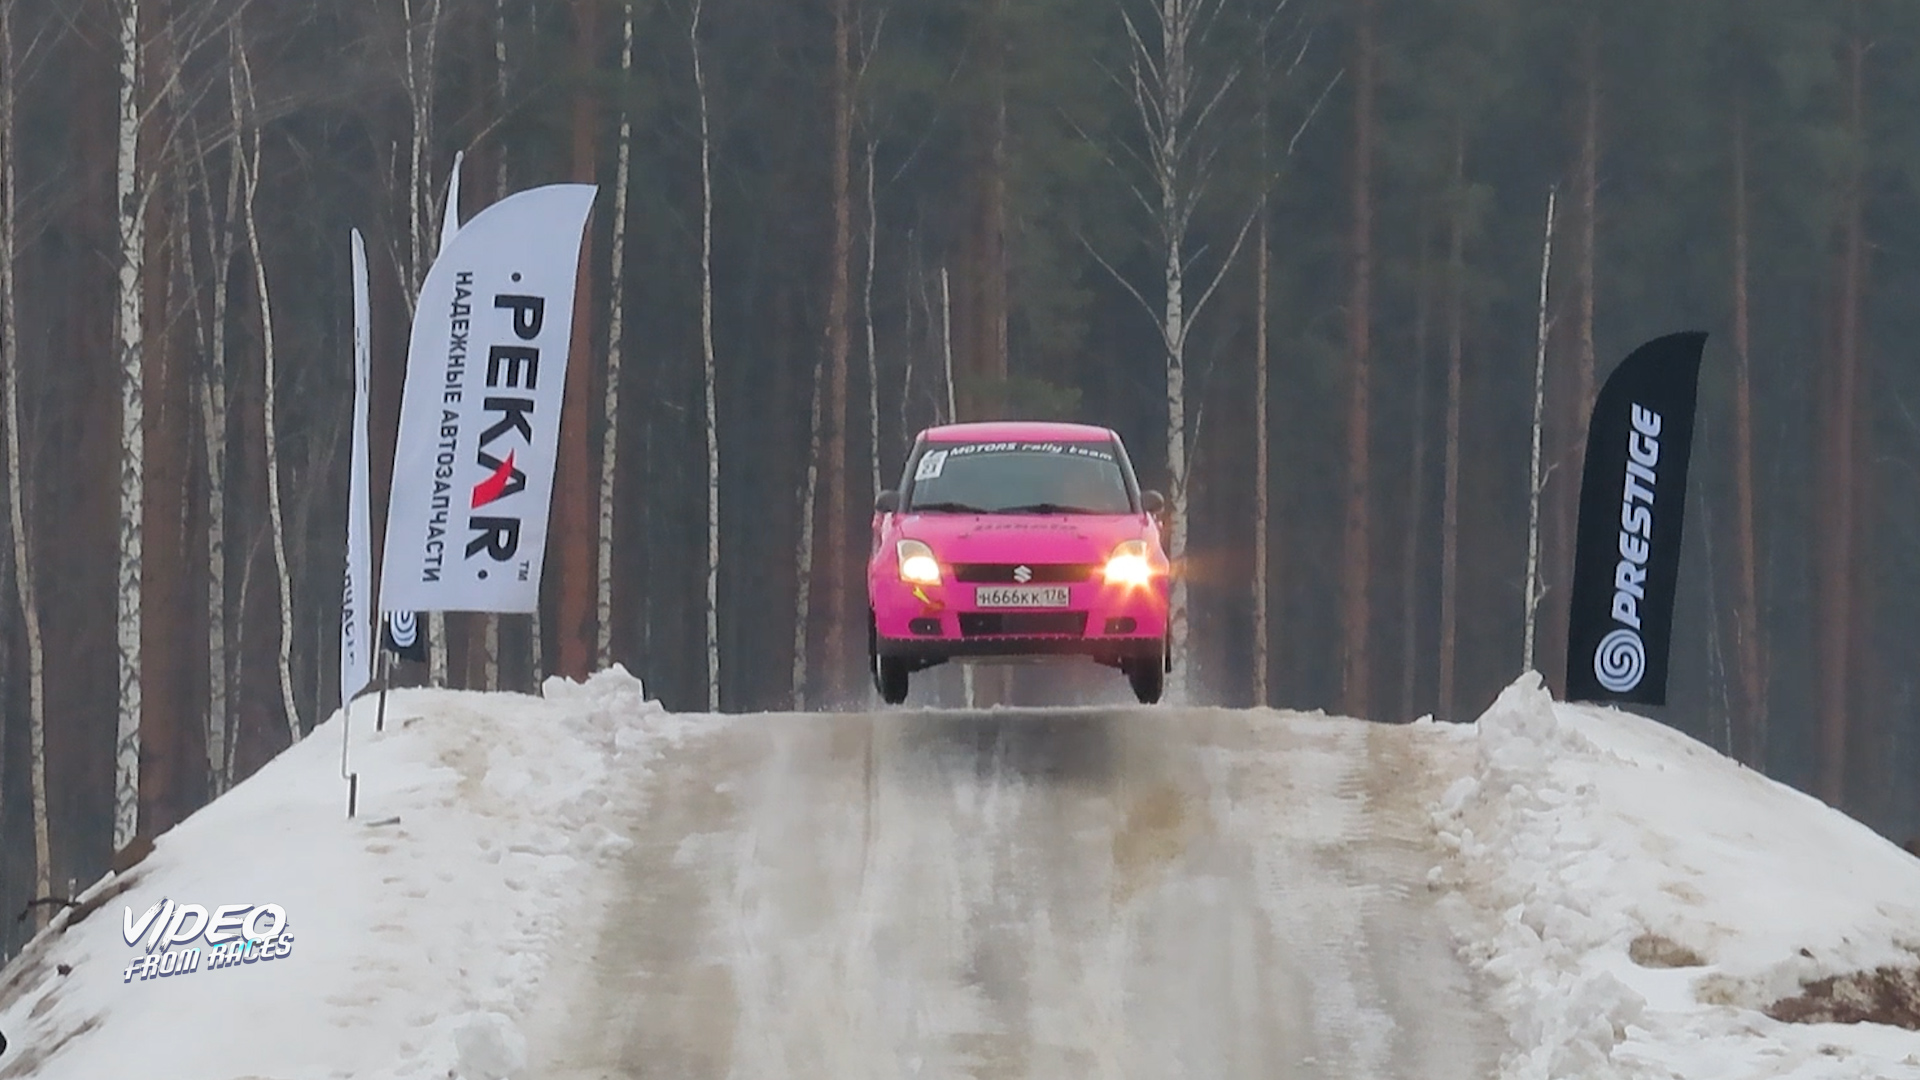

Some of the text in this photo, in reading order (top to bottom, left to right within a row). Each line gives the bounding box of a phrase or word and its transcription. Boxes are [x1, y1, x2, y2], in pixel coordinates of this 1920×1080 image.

[422, 271, 473, 582] НАДЕЖНЫЕ АВТОЗАПЧАСТИ
[465, 295, 544, 562] PEKAR
[950, 442, 1113, 461] MOTORS rally team
[1612, 402, 1663, 630] PRESTIGE
